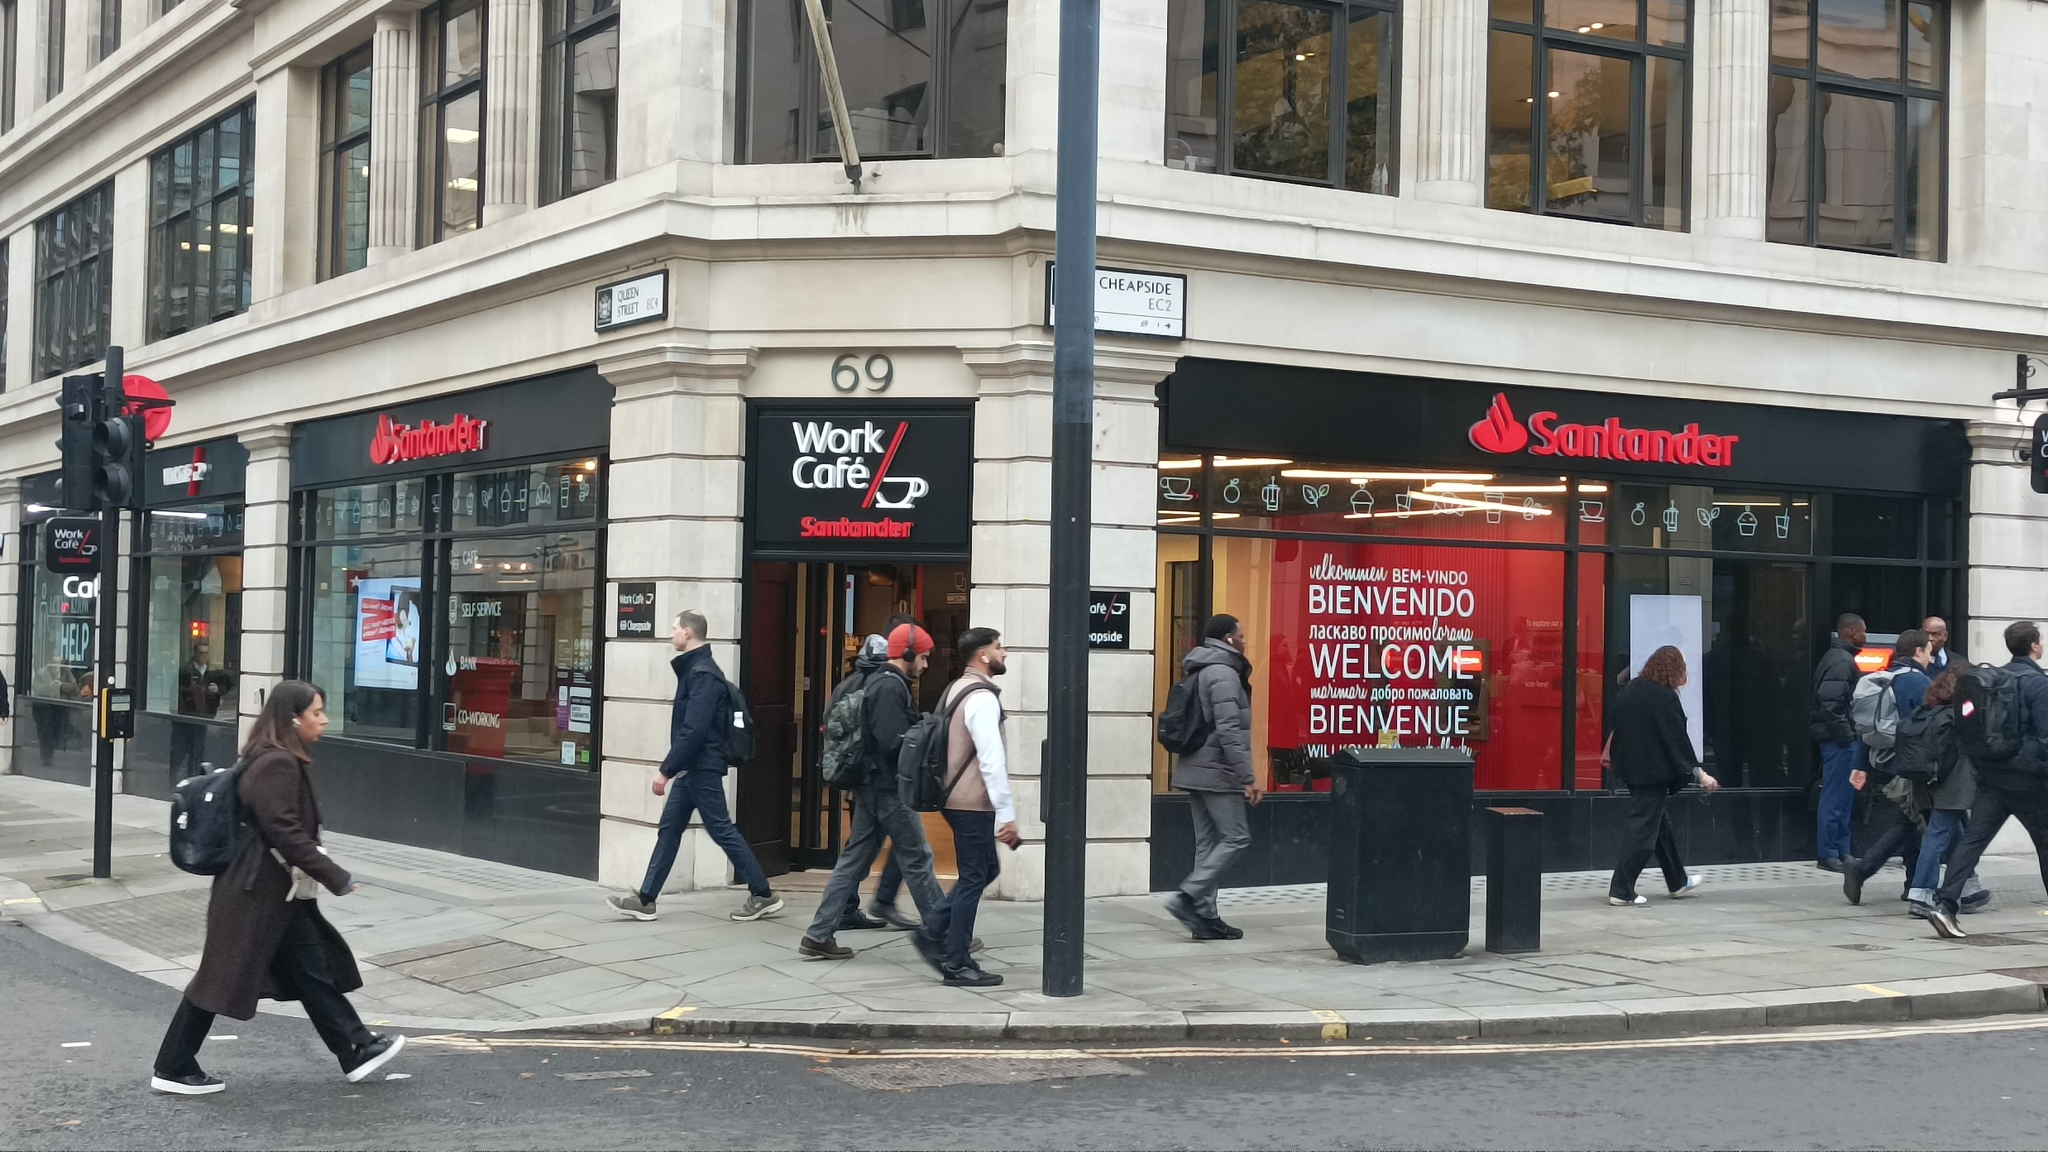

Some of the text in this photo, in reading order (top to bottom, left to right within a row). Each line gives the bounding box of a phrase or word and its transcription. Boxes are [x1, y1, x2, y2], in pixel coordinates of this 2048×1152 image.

[617, 286, 639, 303] QUEEN
[1099, 277, 1172, 295] CHEAPSIDE
[617, 301, 639, 317] STREET
[646, 297, 659, 311] EC4
[1148, 298, 1172, 312] EC2
[831, 353, 894, 394] 69
[388, 413, 487, 463] Santander
[792, 421, 885, 453] Work
[1528, 411, 1739, 467] Santander
[792, 456, 870, 489] Café
[54, 528, 84, 539] Work
[800, 517, 914, 538] Santander
[54, 539, 80, 549] Café
[1309, 553, 1468, 585] velkommen BEM-VINDO
[461, 601, 502, 617] SELF SERVICE
[1089, 602, 1106, 614] afé
[1308, 584, 1475, 617] BIENVENIDO
[61, 622, 90, 662] HELP
[1088, 630, 1123, 645] apside
[1309, 624, 1432, 645] ласкаво просимо
[460, 656, 477, 671] BANK
[1308, 643, 1474, 680] WELCOME
[1370, 684, 1405, 703] добро
[1407, 687, 1473, 701] пожаловать
[457, 708, 501, 729] CO-WORKING
[1310, 704, 1469, 735] BIENVENUE
